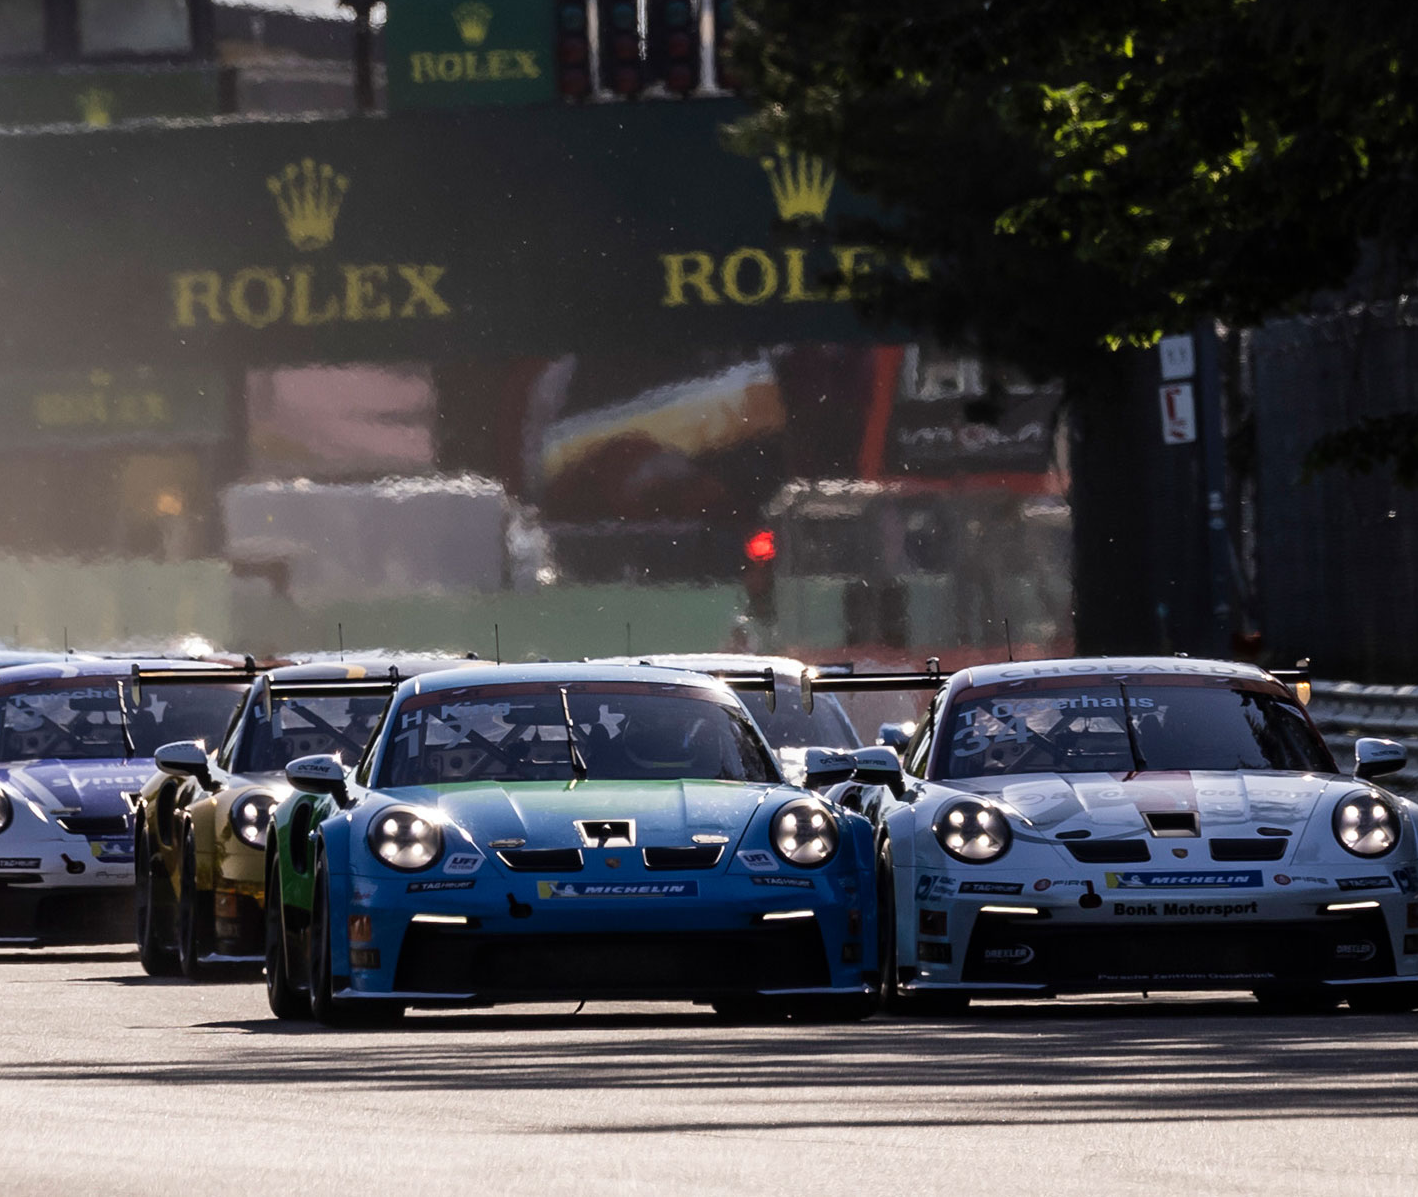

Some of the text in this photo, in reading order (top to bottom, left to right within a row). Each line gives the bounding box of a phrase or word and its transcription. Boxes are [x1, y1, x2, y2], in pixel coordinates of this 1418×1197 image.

[409, 49, 542, 84] ROLEX
[171, 262, 452, 329] ROLEX
[441, 701, 511, 719] King
[992, 694, 1154, 718] Oeverhaus
[394, 719, 474, 759] 19
[953, 716, 1034, 758] 34
[451, 857, 479, 866] UFI
[744, 853, 769, 863] UFI
[1150, 875, 1250, 885] MICHELIN
[584, 885, 685, 894] MICHELIN
[1114, 901, 1259, 918] Bonk Motorsport
[985, 948, 1028, 959] DREXLER
